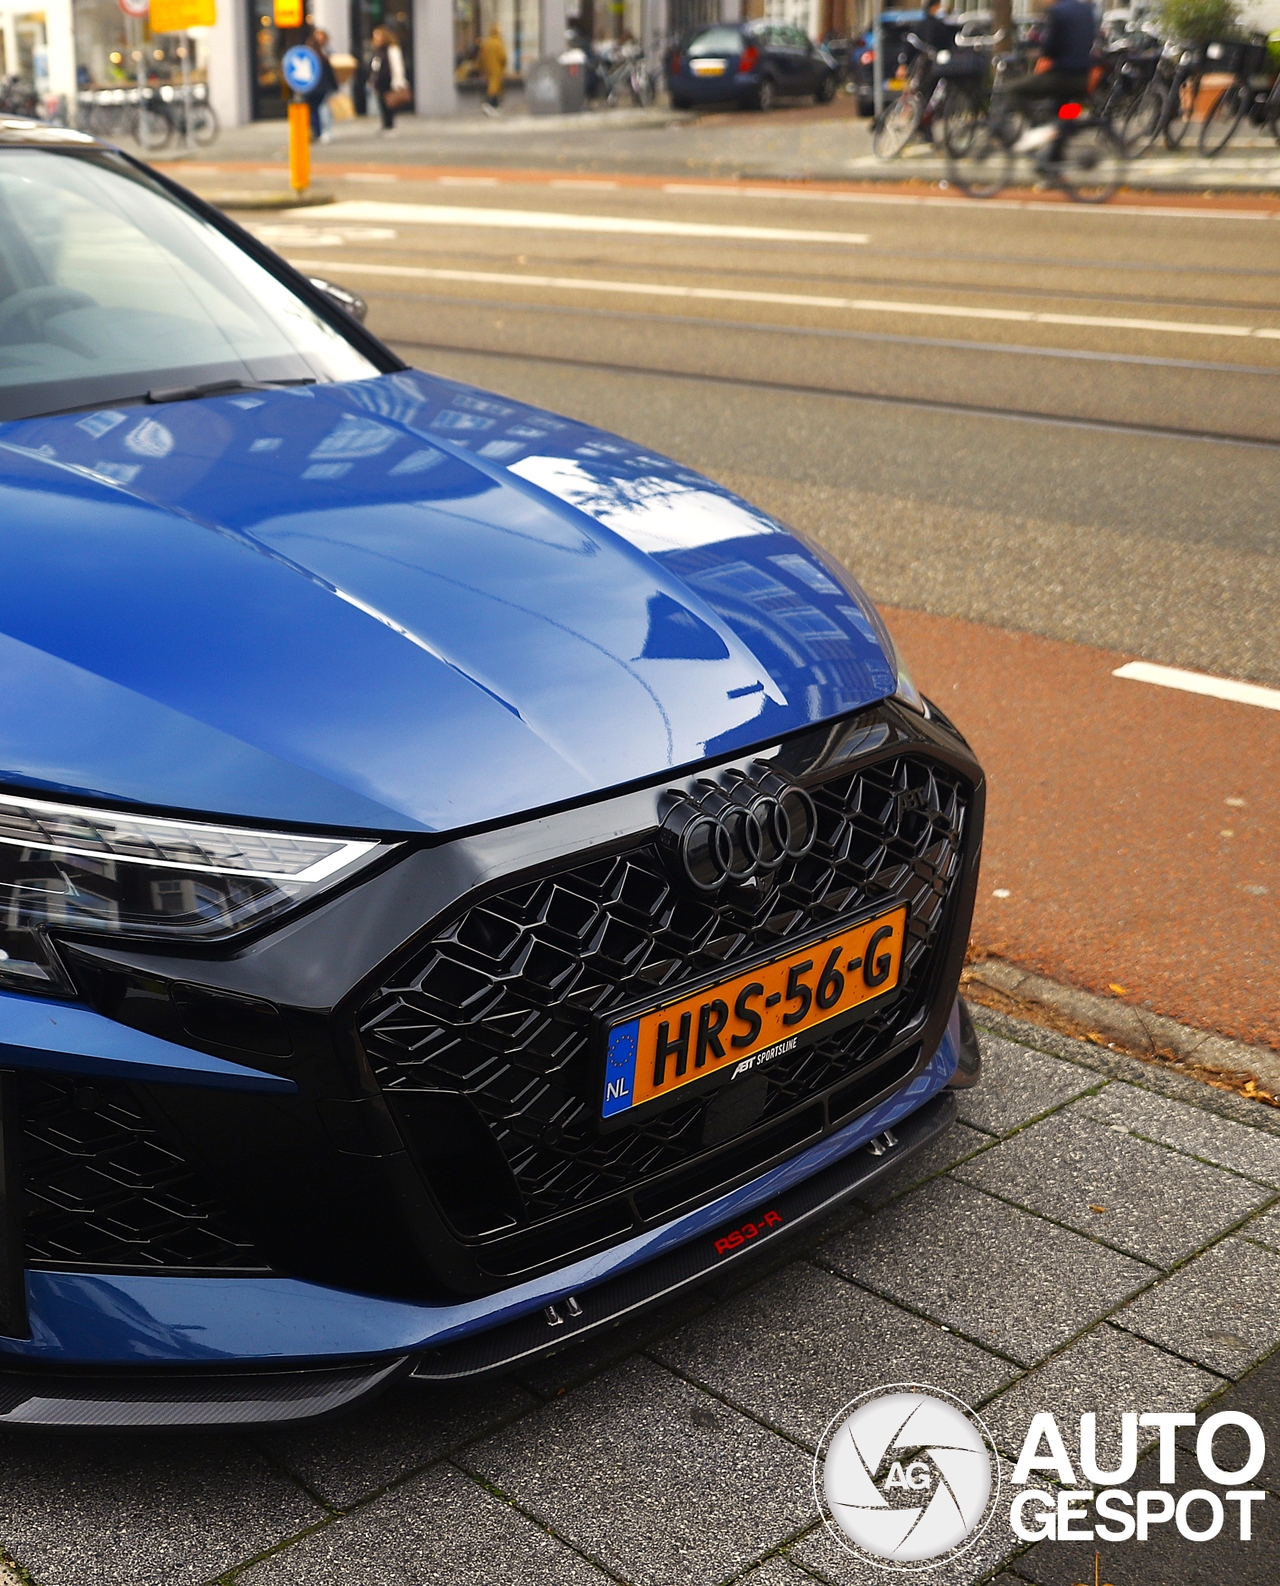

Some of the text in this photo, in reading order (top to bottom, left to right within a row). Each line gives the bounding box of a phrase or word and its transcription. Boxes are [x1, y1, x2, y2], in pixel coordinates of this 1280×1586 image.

[653, 925, 893, 1086] HRS-56-G
[731, 1037, 798, 1080] ABT SPORTSLINE
[606, 1077, 629, 1101] NL
[713, 1210, 783, 1255] RS3-R
